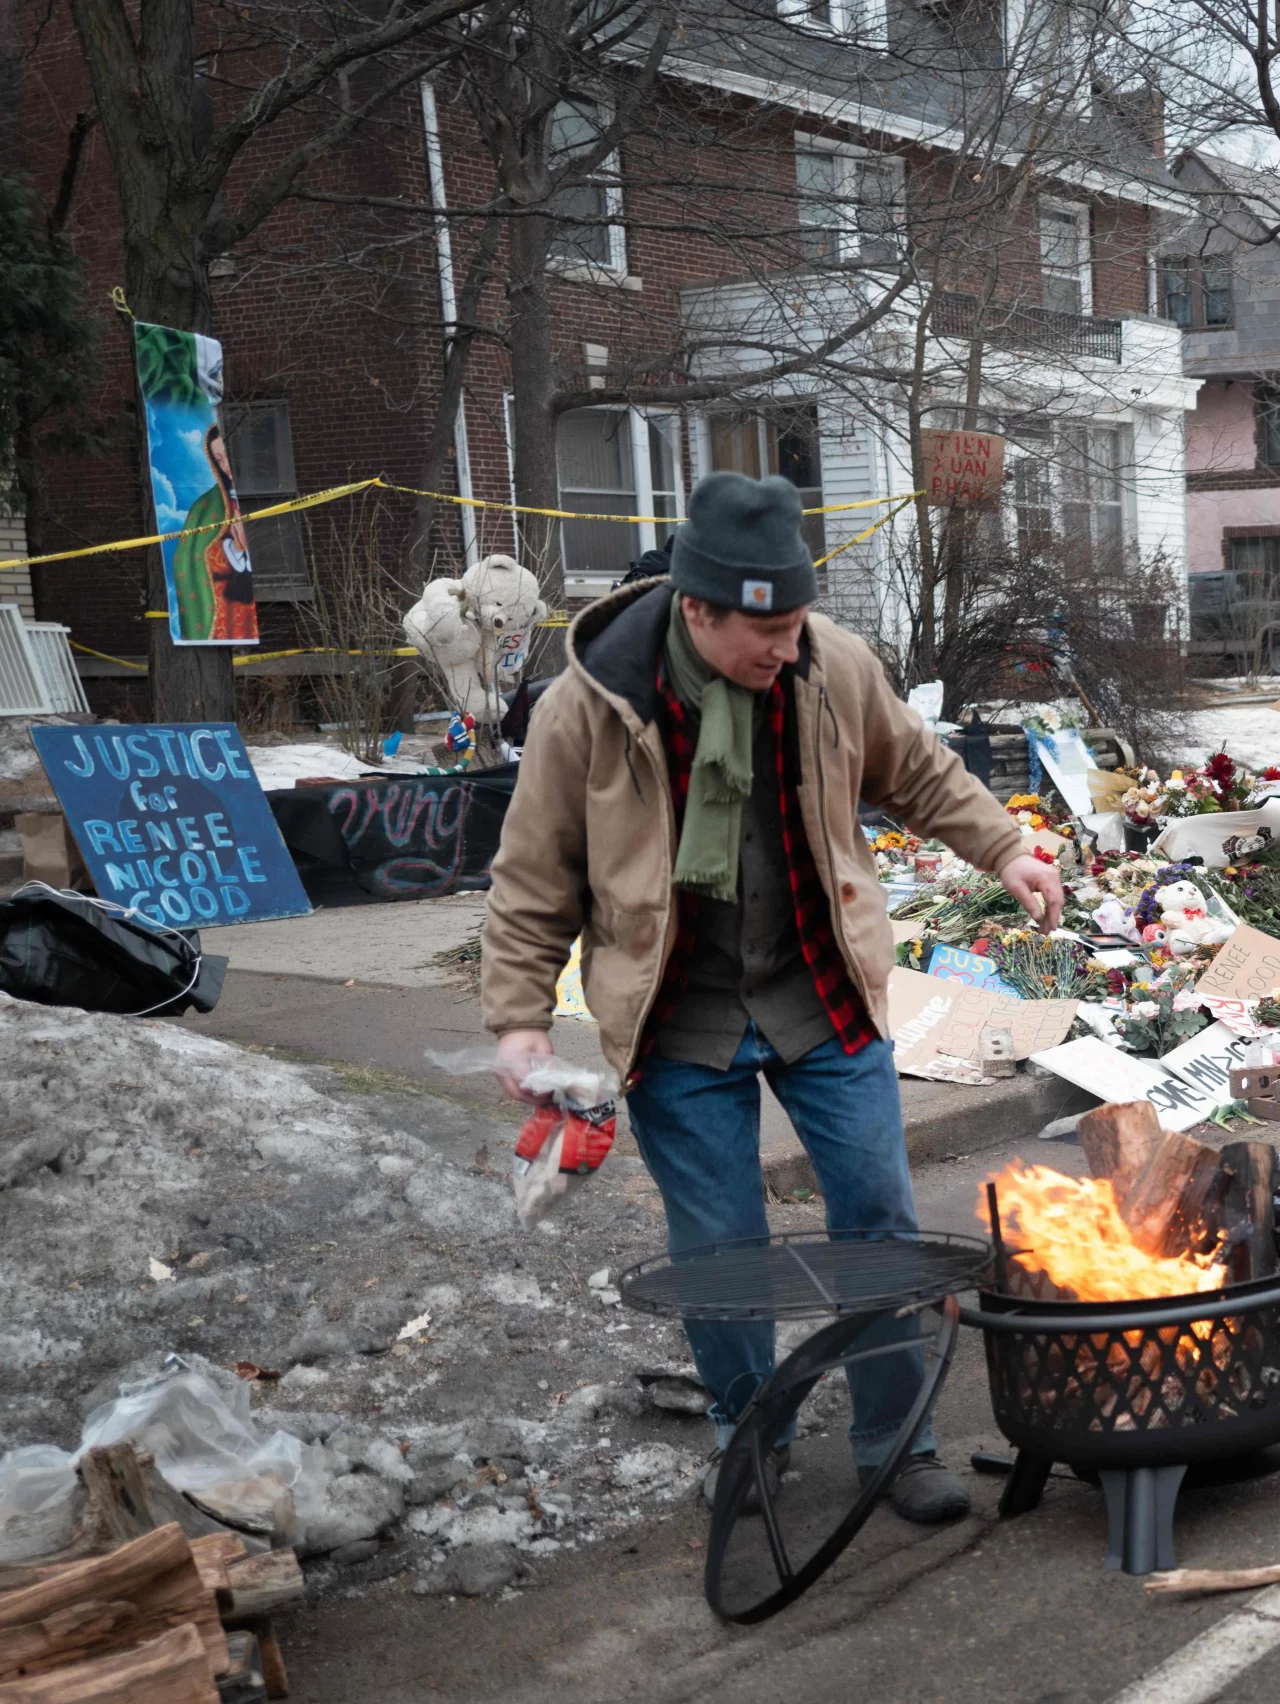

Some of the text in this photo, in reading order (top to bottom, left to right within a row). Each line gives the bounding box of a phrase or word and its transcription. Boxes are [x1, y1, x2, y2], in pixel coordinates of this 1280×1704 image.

[933, 435, 990, 458] TIEN
[934, 456, 986, 477] XUAN
[64, 729, 250, 781] JUSTICE
[84, 812, 233, 855] RENEE
[104, 846, 267, 891] NICOLE
[129, 885, 250, 926] GOOD
[1203, 943, 1252, 993] RENEE
